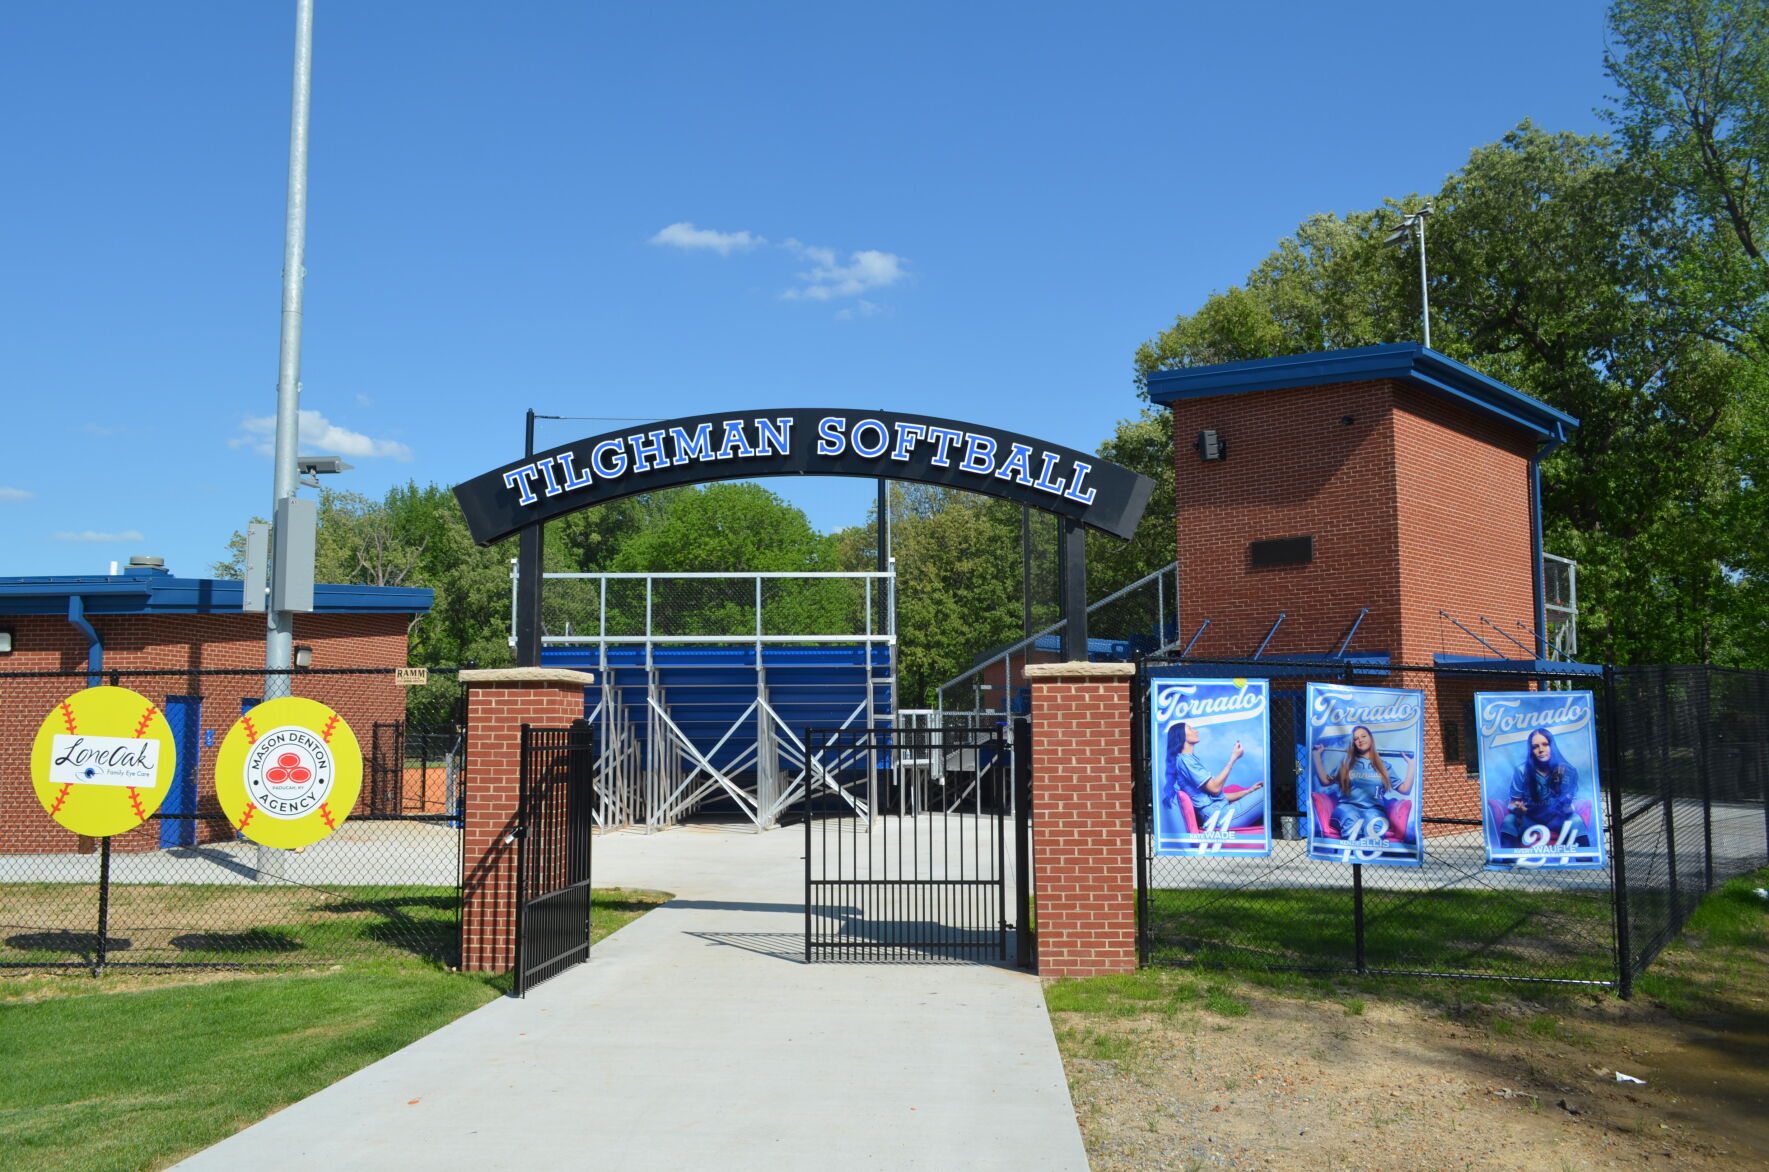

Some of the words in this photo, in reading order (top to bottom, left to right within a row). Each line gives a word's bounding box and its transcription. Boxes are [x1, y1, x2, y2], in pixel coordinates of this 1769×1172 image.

[503, 417, 793, 506] TILGHMAN
[817, 417, 1097, 506] SOFTBALL
[397, 669, 425, 678] RAMM
[1156, 683, 1266, 724] Tornado
[1311, 694, 1421, 728] Tornado
[1481, 697, 1592, 737] Tornado
[252, 734, 285, 770] MASON
[289, 733, 327, 769] DENTON
[106, 769, 125, 777] Family
[259, 792, 316, 812] AGENCY
[1197, 808, 1235, 855] 11
[1204, 831, 1236, 839] WADE
[1341, 816, 1390, 862] 18
[1360, 839, 1390, 847] ELLIS
[1516, 820, 1579, 868] 24
[1532, 844, 1577, 853] WAUFLE
